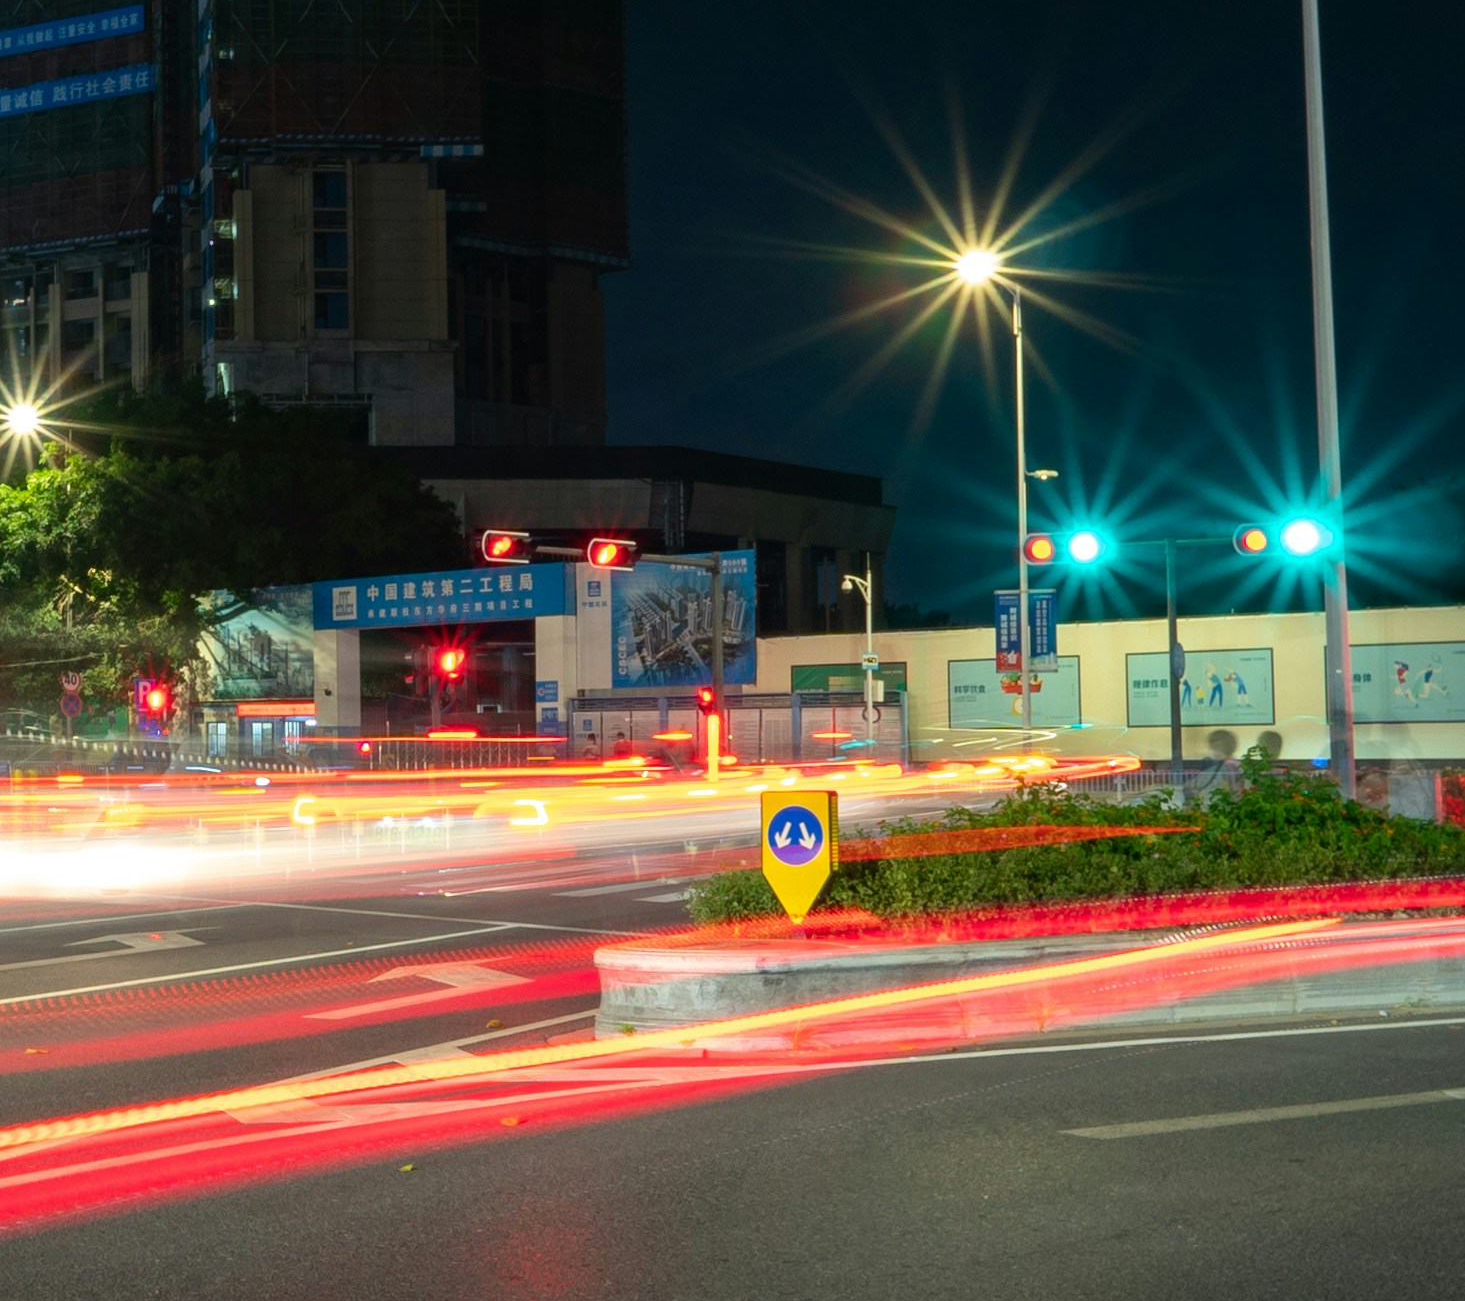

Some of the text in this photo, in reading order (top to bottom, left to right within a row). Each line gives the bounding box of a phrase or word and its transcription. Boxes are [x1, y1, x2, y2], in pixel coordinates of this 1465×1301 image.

[52, 70, 149, 103] 践行社会责任
[367, 573, 534, 602] 中国建筑第二工程局
[64, 673, 77, 686] 40
